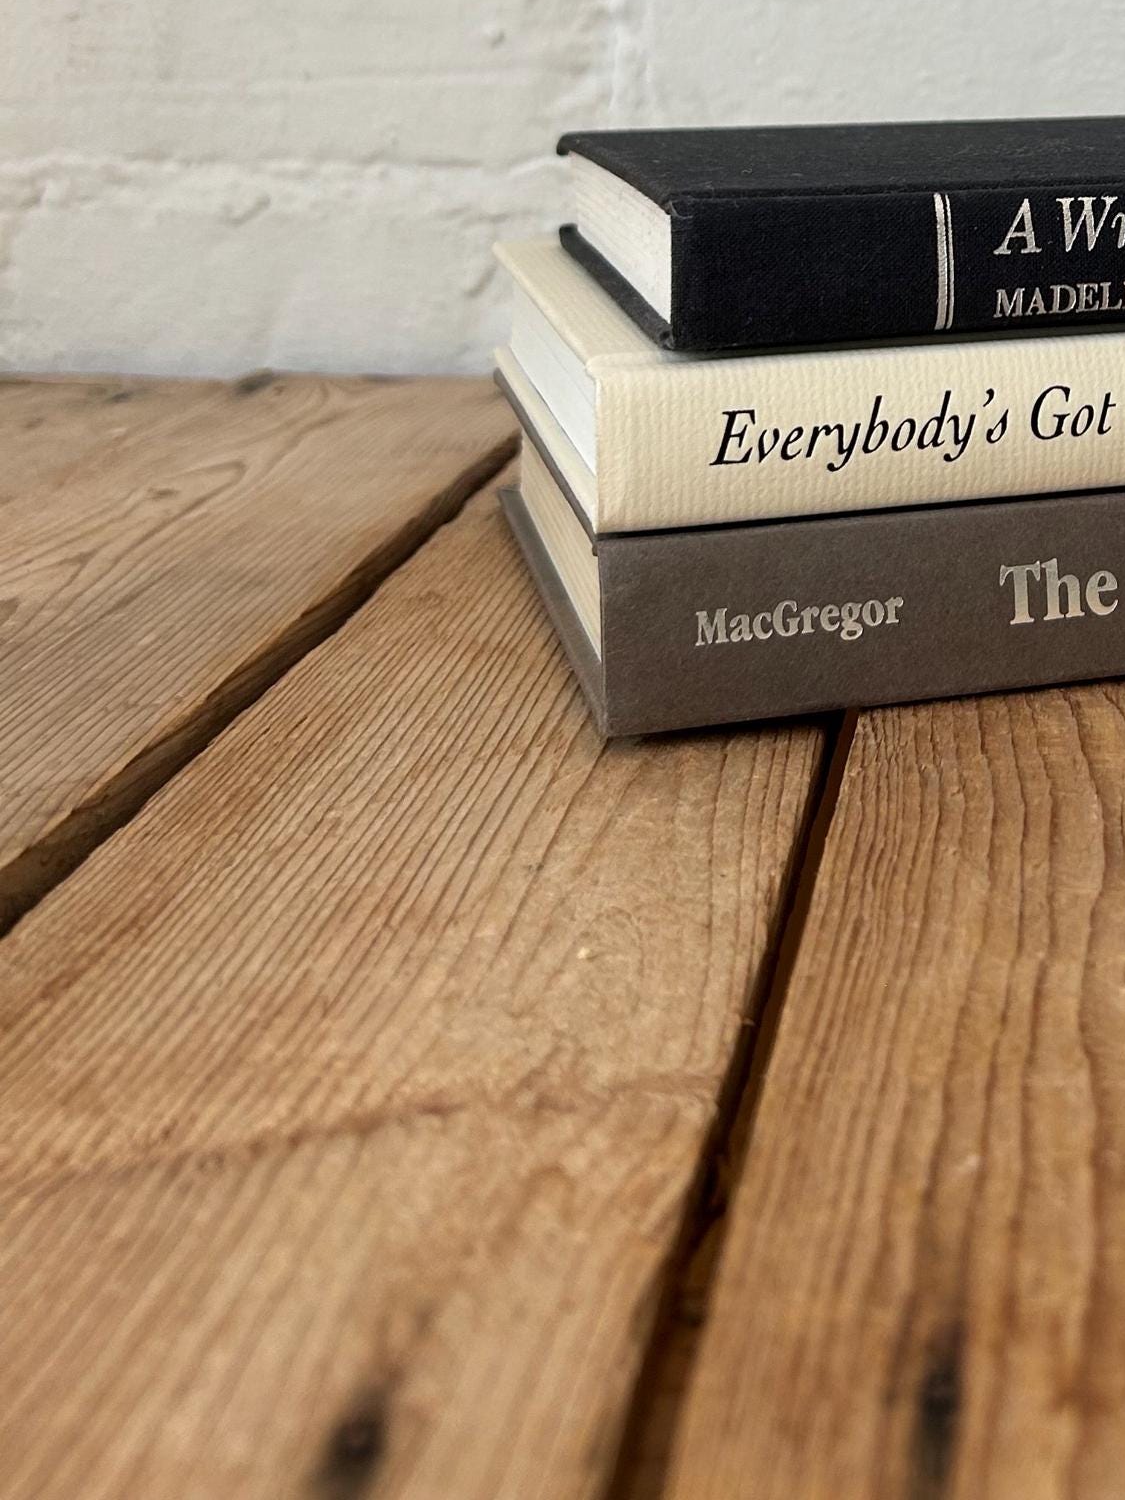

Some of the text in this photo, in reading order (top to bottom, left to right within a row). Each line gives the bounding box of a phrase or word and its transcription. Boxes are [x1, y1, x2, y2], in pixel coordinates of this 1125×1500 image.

[994, 197, 1042, 255] A
[708, 388, 1009, 473] Everybody's
[1030, 385, 1117, 441] Got
[694, 594, 904, 647] MacGregor
[999, 557, 1120, 626] The
